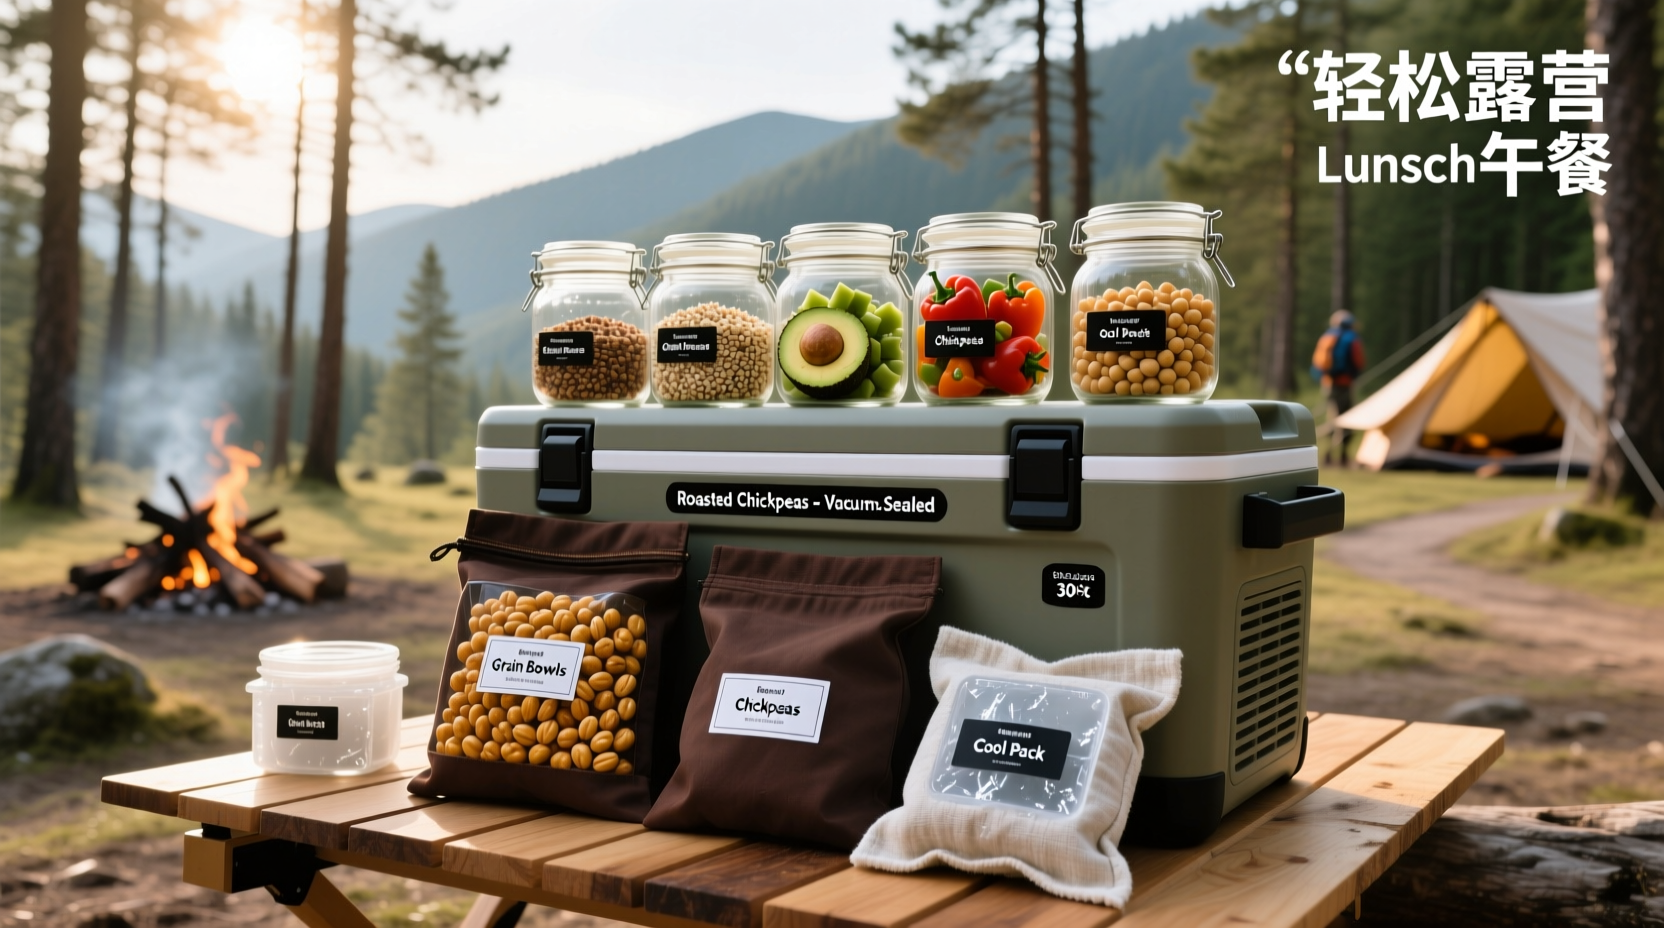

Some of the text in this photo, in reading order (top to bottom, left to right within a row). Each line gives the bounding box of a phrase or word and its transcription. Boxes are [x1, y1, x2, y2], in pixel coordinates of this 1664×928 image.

[677, 490, 733, 507] Roasted
[737, 491, 809, 513] Chickpeas
[492, 658, 567, 677] Grain Bowls
[735, 697, 801, 718] Chickpeas
[973, 738, 1046, 762] Cool Pack
